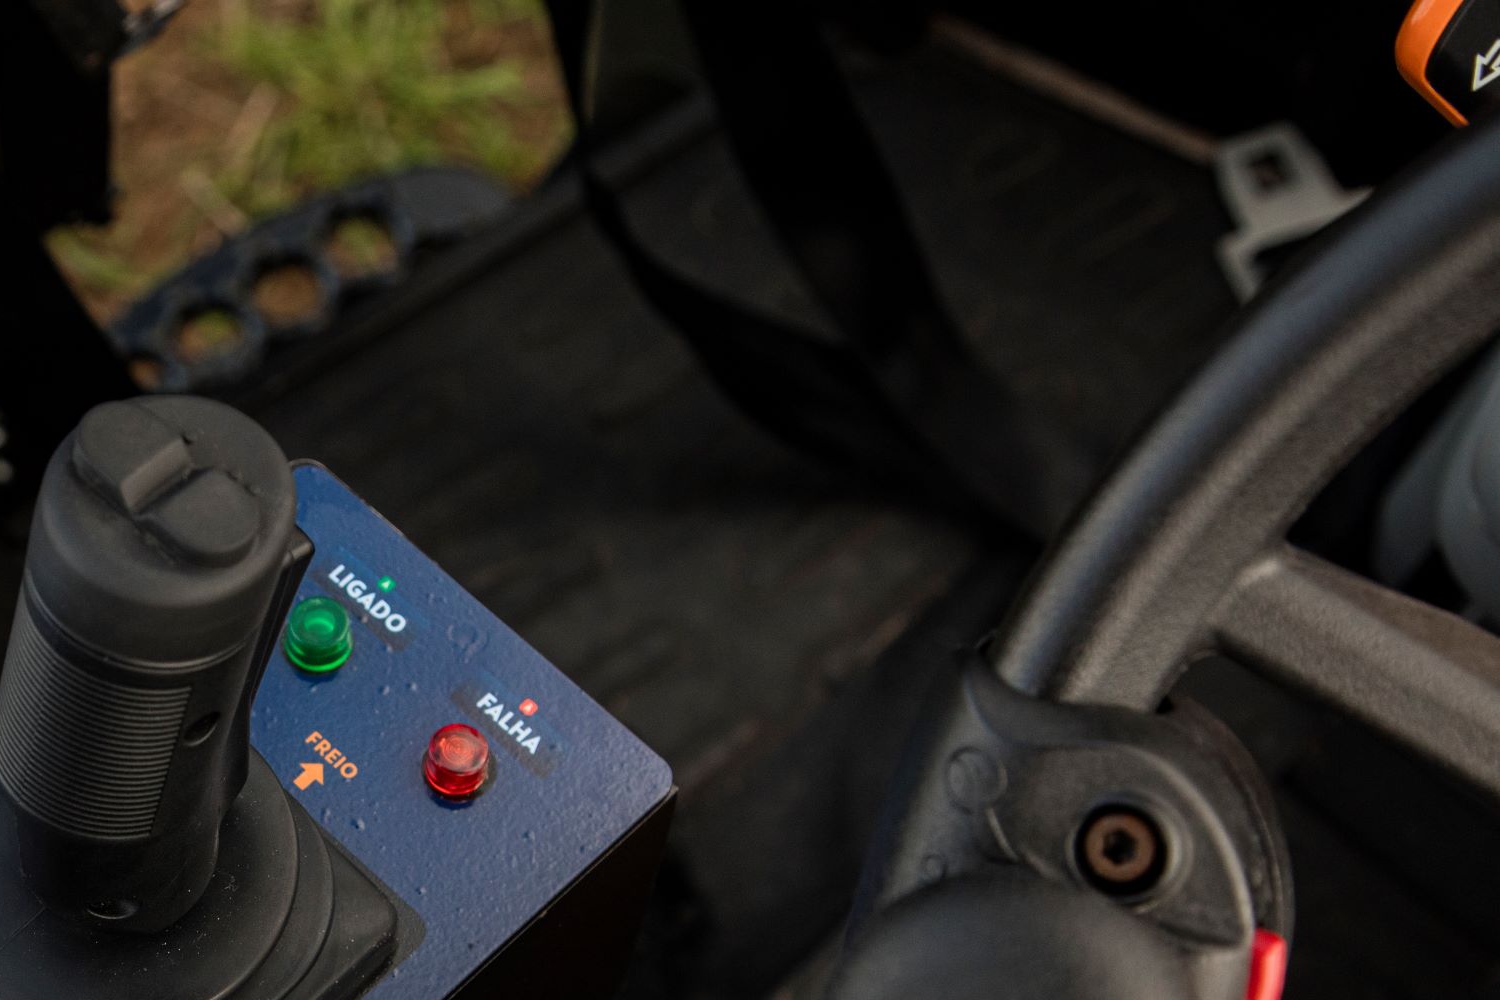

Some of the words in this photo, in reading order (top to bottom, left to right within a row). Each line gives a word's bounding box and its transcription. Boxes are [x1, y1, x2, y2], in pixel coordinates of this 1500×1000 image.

[328, 564, 406, 633] LIGADO
[304, 730, 358, 780] FREIO
[476, 692, 541, 755] FALHA
